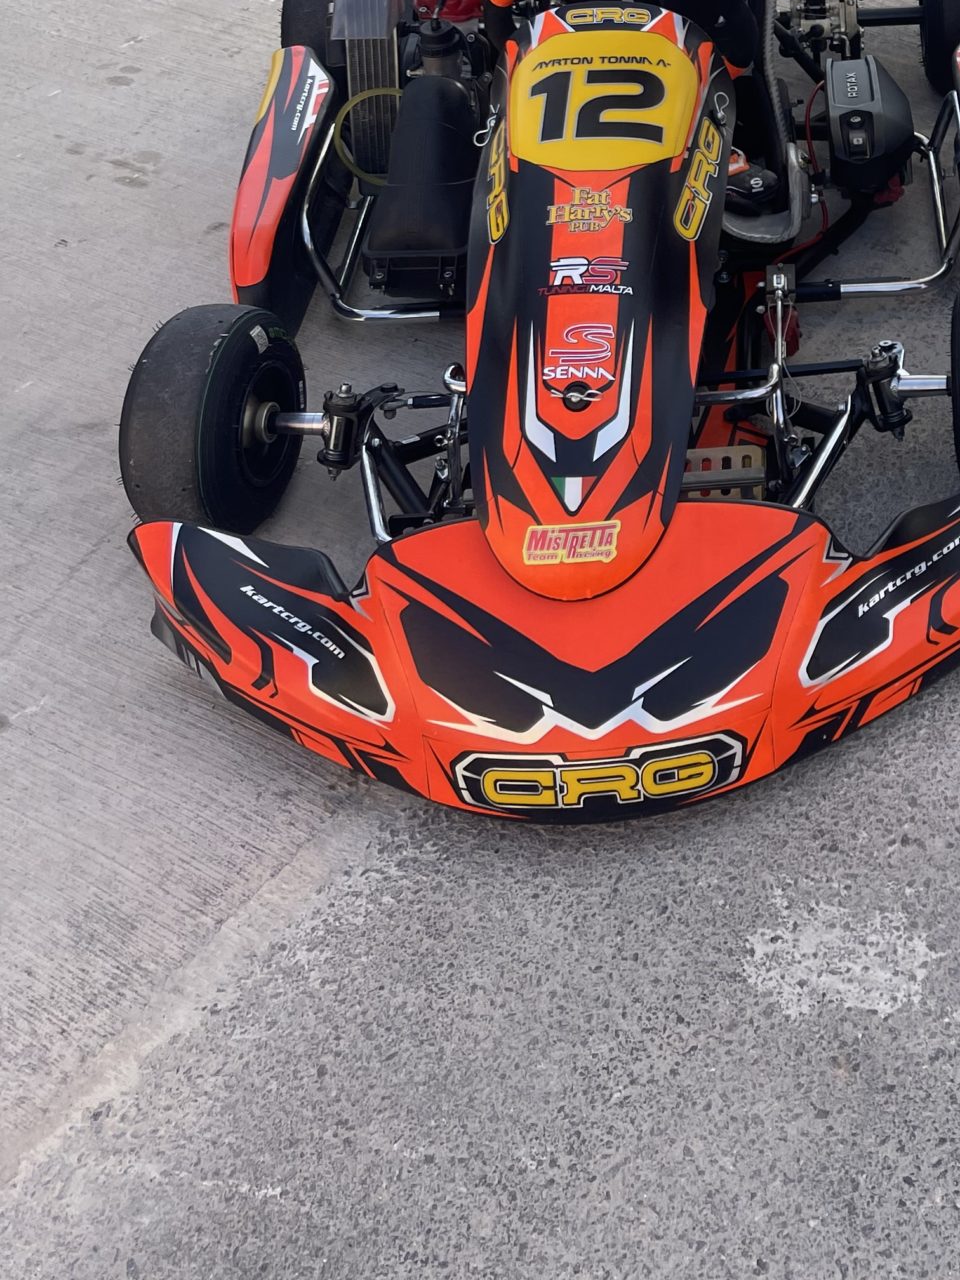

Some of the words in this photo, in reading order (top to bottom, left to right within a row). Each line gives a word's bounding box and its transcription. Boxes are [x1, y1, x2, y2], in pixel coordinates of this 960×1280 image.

[565, 8, 652, 25] CRG
[532, 56, 593, 72] AYRTON
[598, 56, 653, 65] TONNA
[846, 71, 859, 98] ROTAX
[291, 78, 314, 131] kartcrg.com
[528, 69, 667, 145] 12
[674, 116, 724, 242] CRG
[571, 186, 611, 206] Fat
[546, 204, 633, 229] Harry's
[568, 221, 601, 233] PUB
[550, 257, 630, 286] RS
[589, 285, 633, 296] MALTA
[542, 365, 616, 381] SENNA
[239, 584, 347, 660] kartcrg.com
[481, 749, 718, 809] CRG
